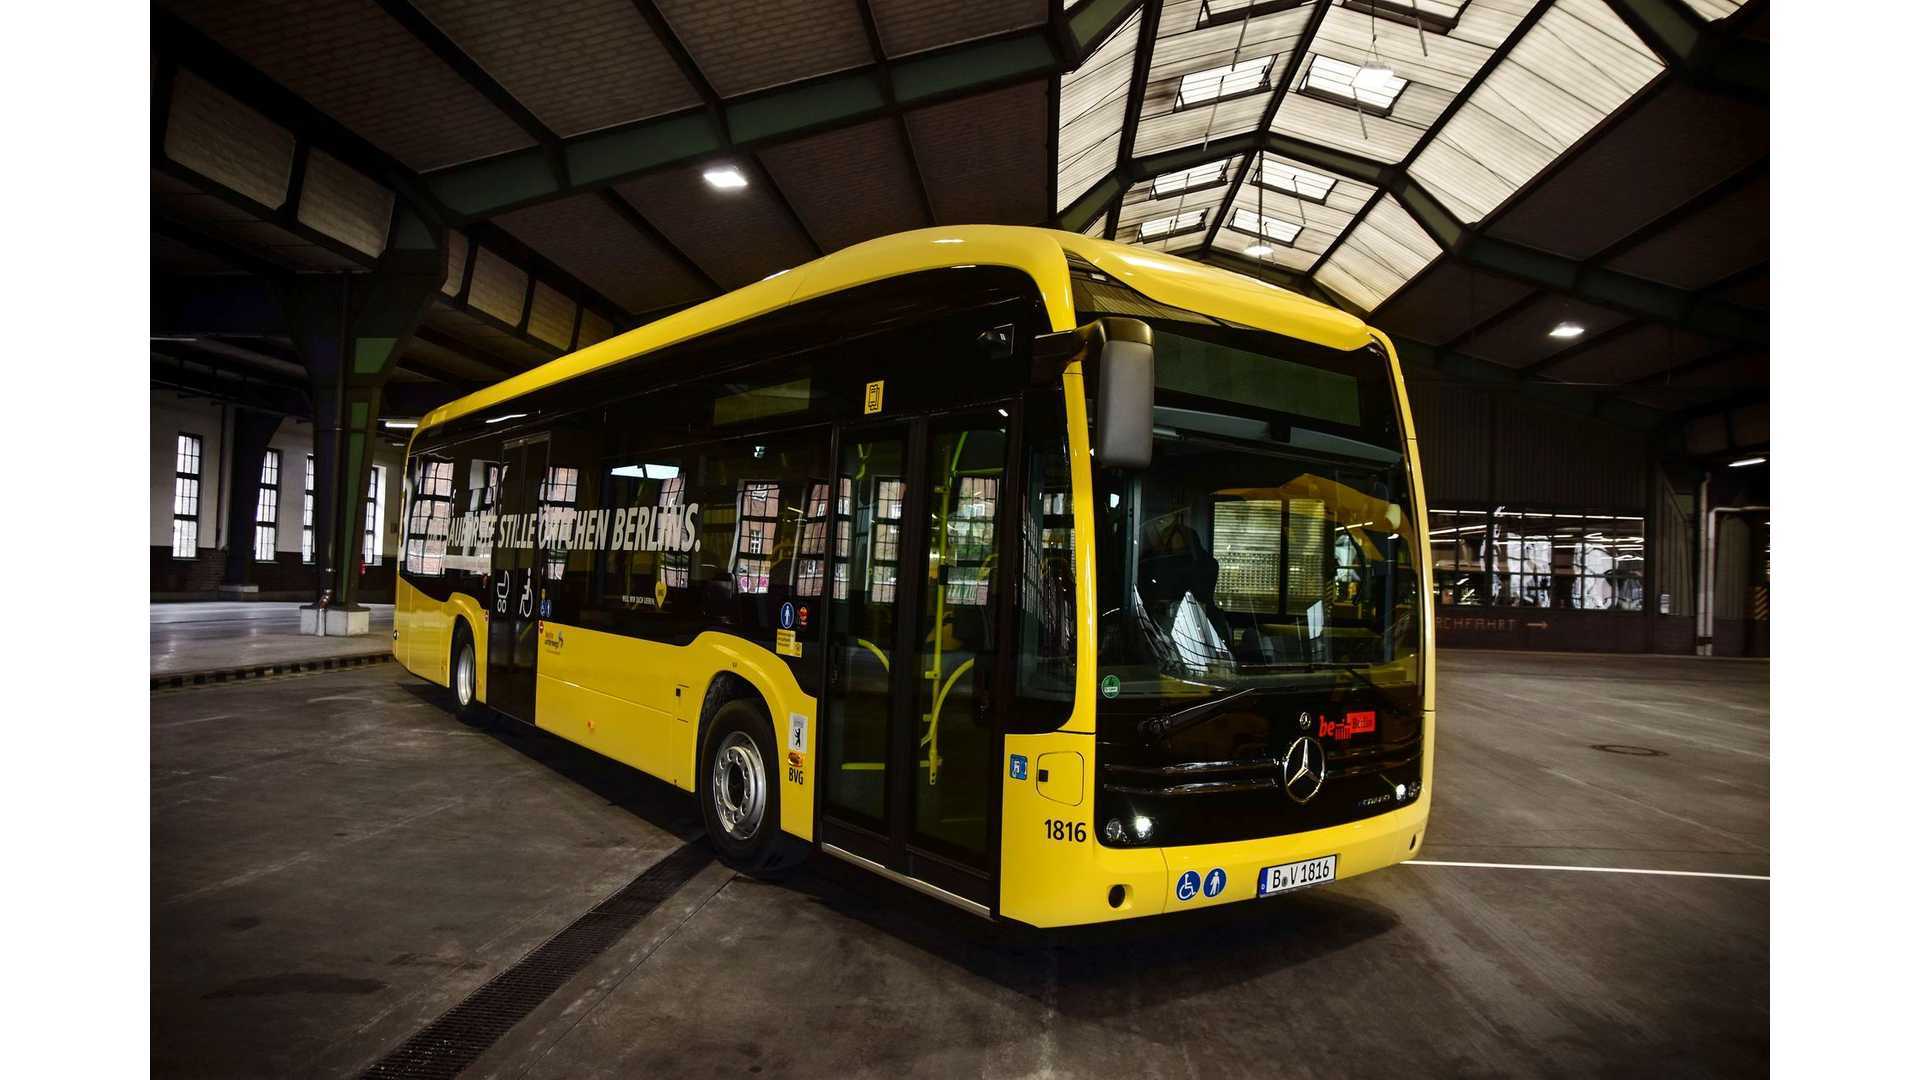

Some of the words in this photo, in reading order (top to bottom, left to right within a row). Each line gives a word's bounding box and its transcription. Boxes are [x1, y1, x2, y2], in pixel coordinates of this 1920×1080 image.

[498, 513, 537, 549] STILLE
[611, 503, 700, 552] BERLINS.
[788, 767, 804, 785] BVG
[1044, 818, 1087, 843] 1816
[1273, 869, 1281, 889] B
[1290, 865, 1299, 886] V
[1300, 860, 1330, 883] 1816
